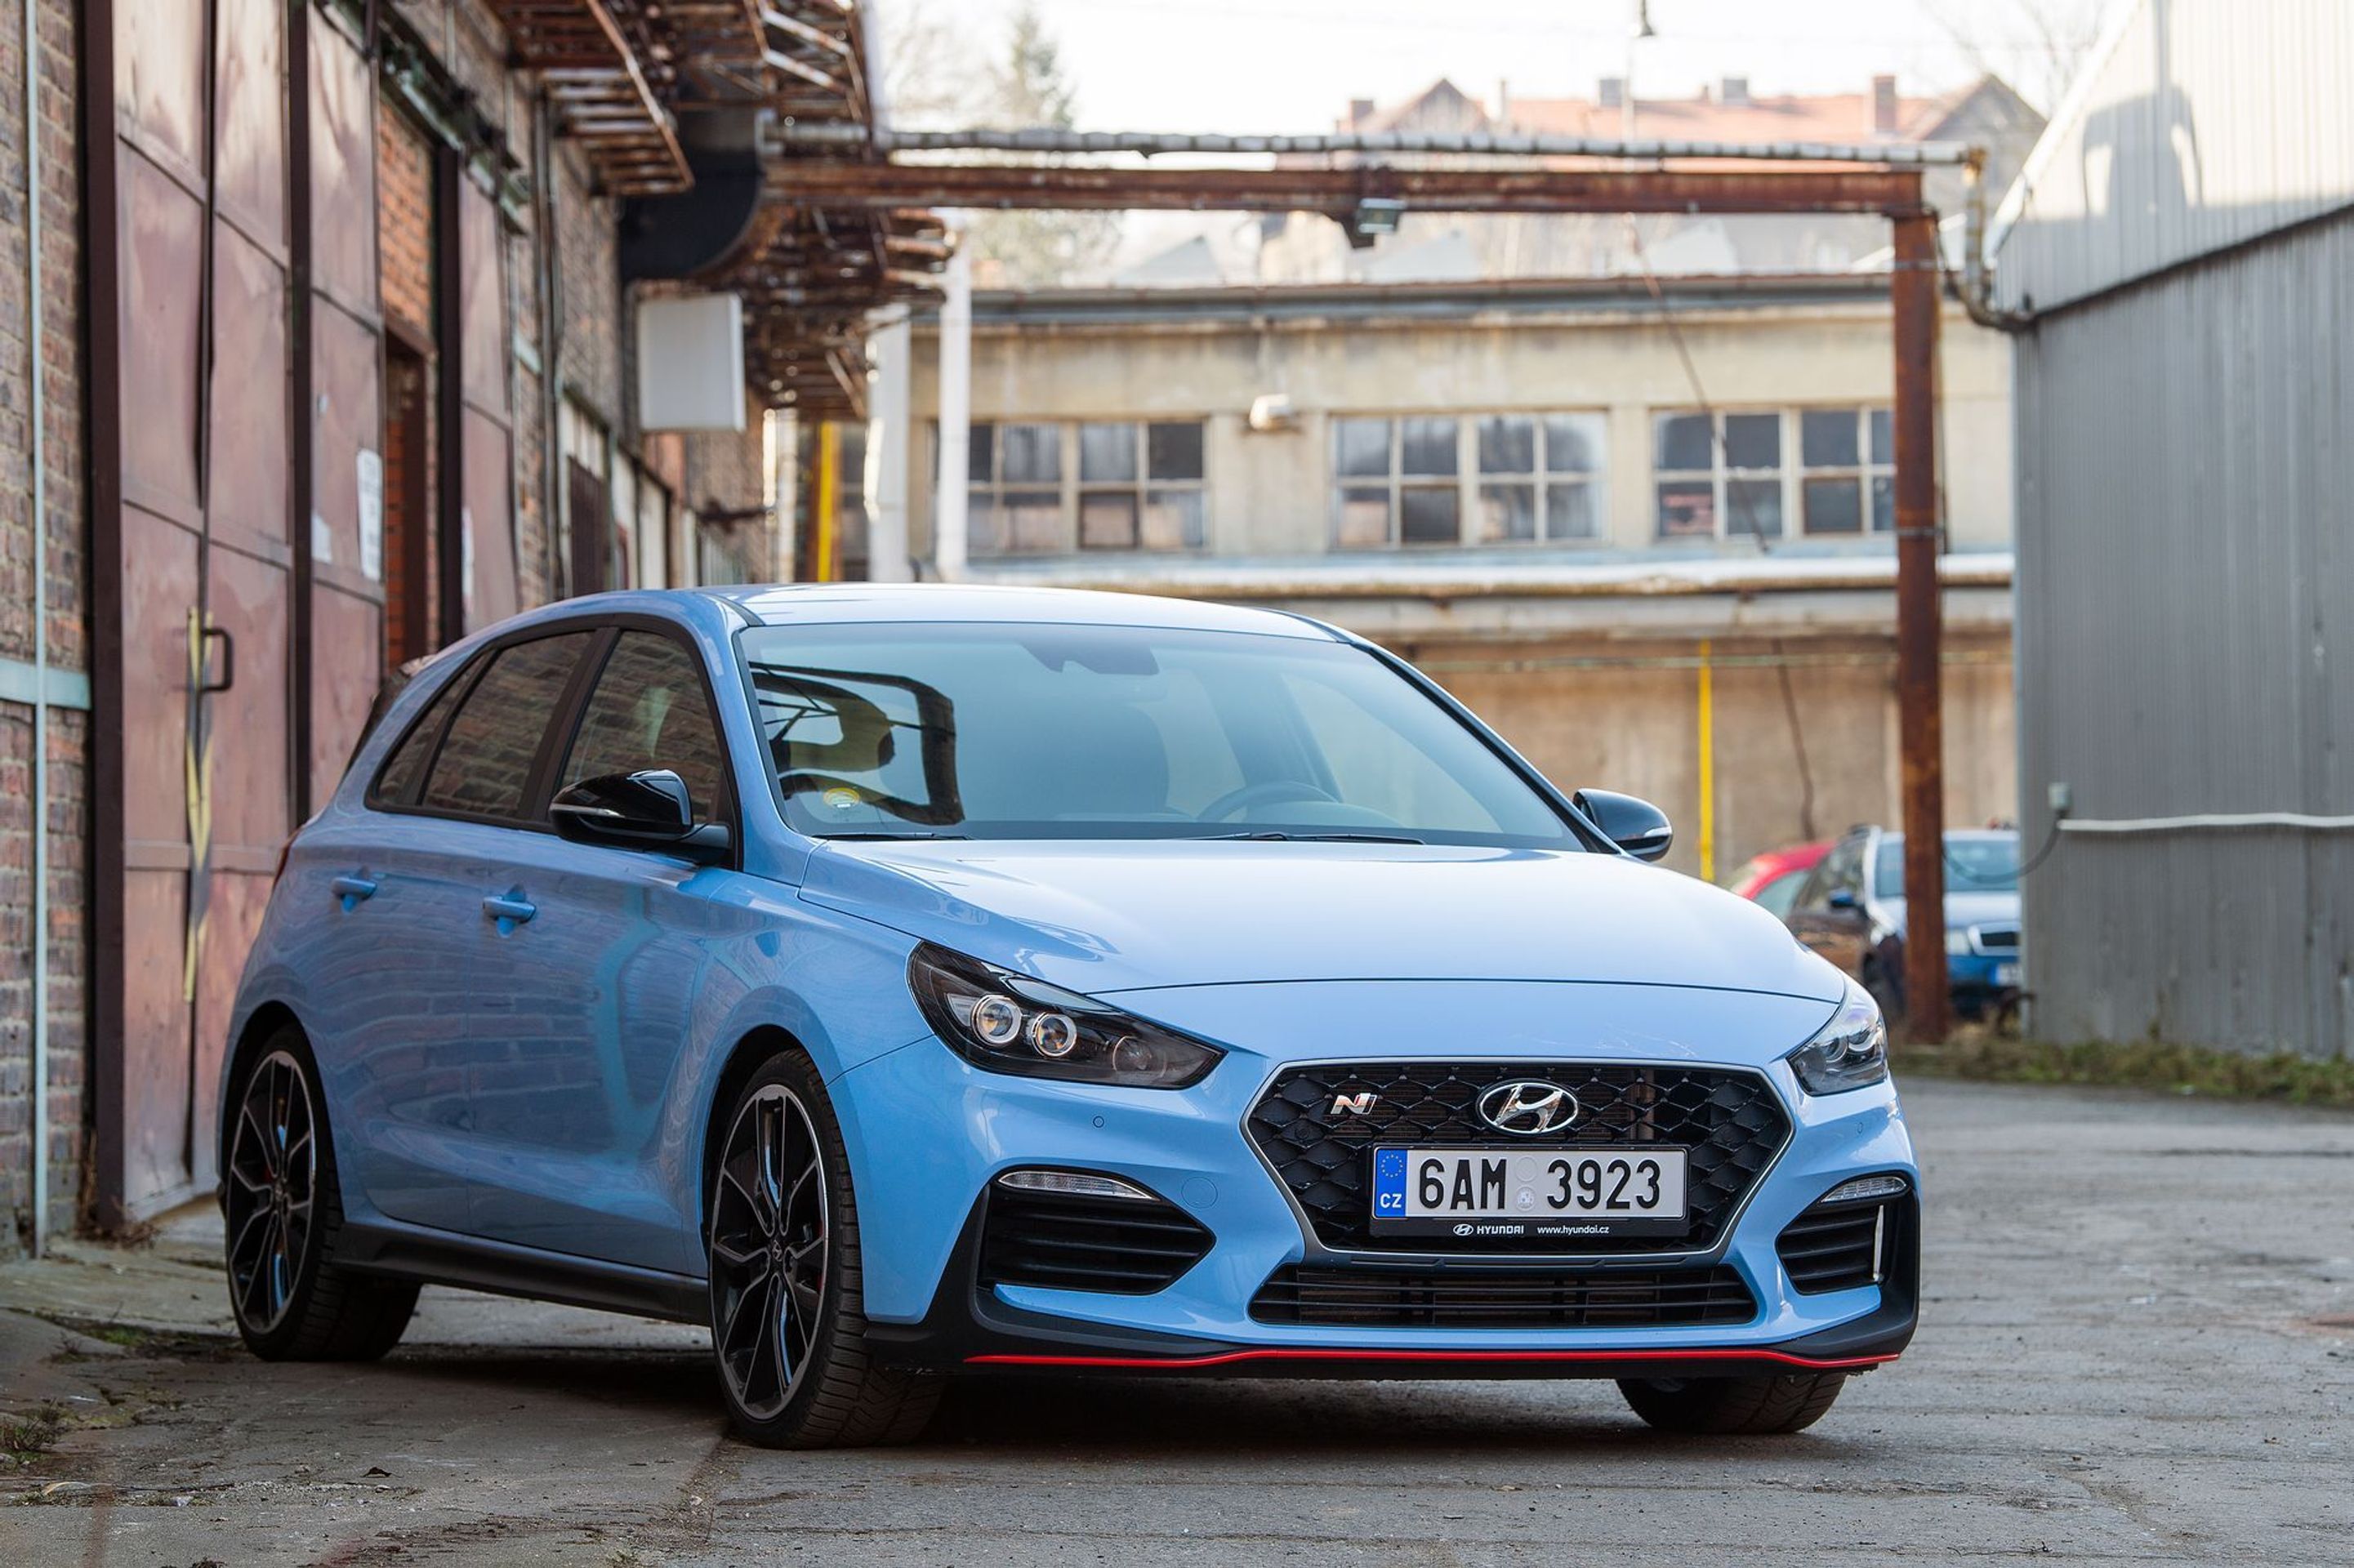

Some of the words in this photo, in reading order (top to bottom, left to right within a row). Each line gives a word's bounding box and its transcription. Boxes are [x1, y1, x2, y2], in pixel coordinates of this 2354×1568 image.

[1420, 1158, 1507, 1209] 6AM
[1547, 1159, 1661, 1209] 3923
[1380, 1193, 1402, 1208] CZ
[1477, 1226, 1524, 1234] HYUNDAI
[1537, 1225, 1609, 1236] www.hyundai.cz
